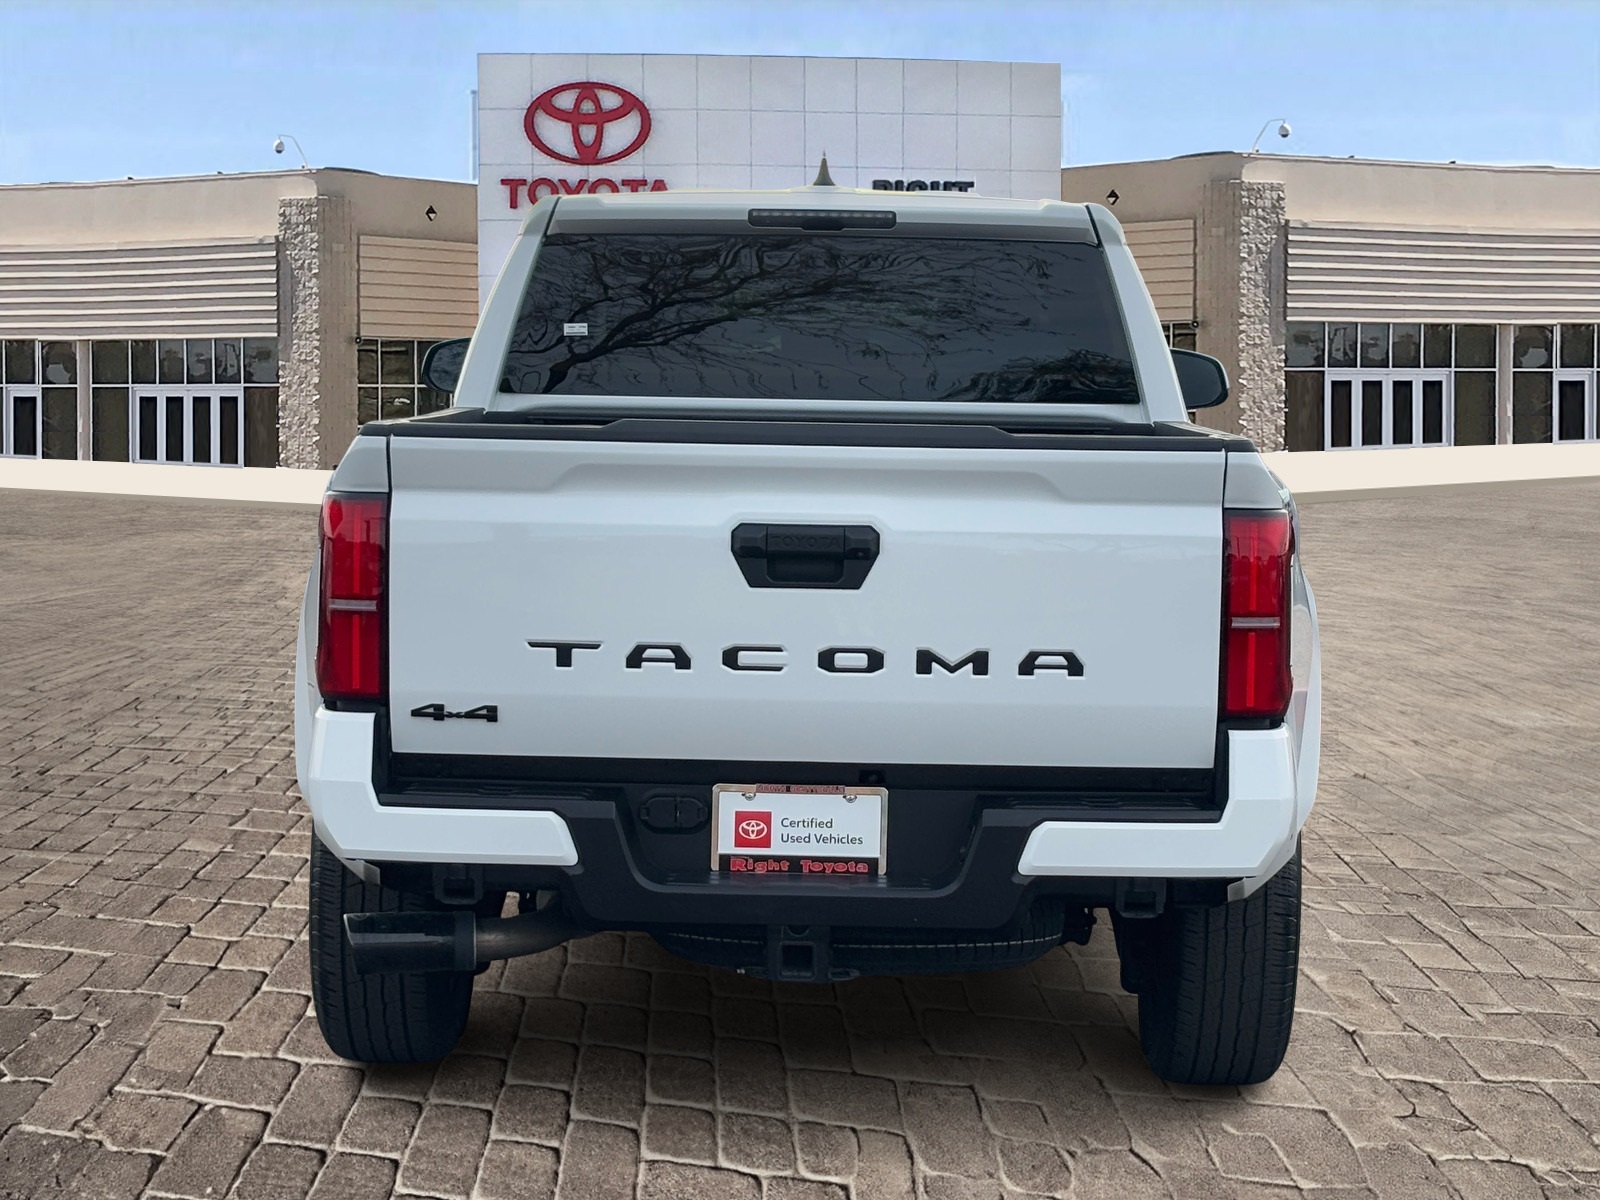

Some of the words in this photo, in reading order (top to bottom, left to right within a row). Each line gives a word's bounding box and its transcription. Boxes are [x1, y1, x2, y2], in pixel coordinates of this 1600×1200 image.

[526, 639, 1085, 677] TACOMA
[780, 817, 833, 829] Certified
[780, 833, 811, 844] Used
[813, 833, 864, 845] Vehicles
[729, 857, 790, 873] Right
[800, 859, 869, 873] Toyota
